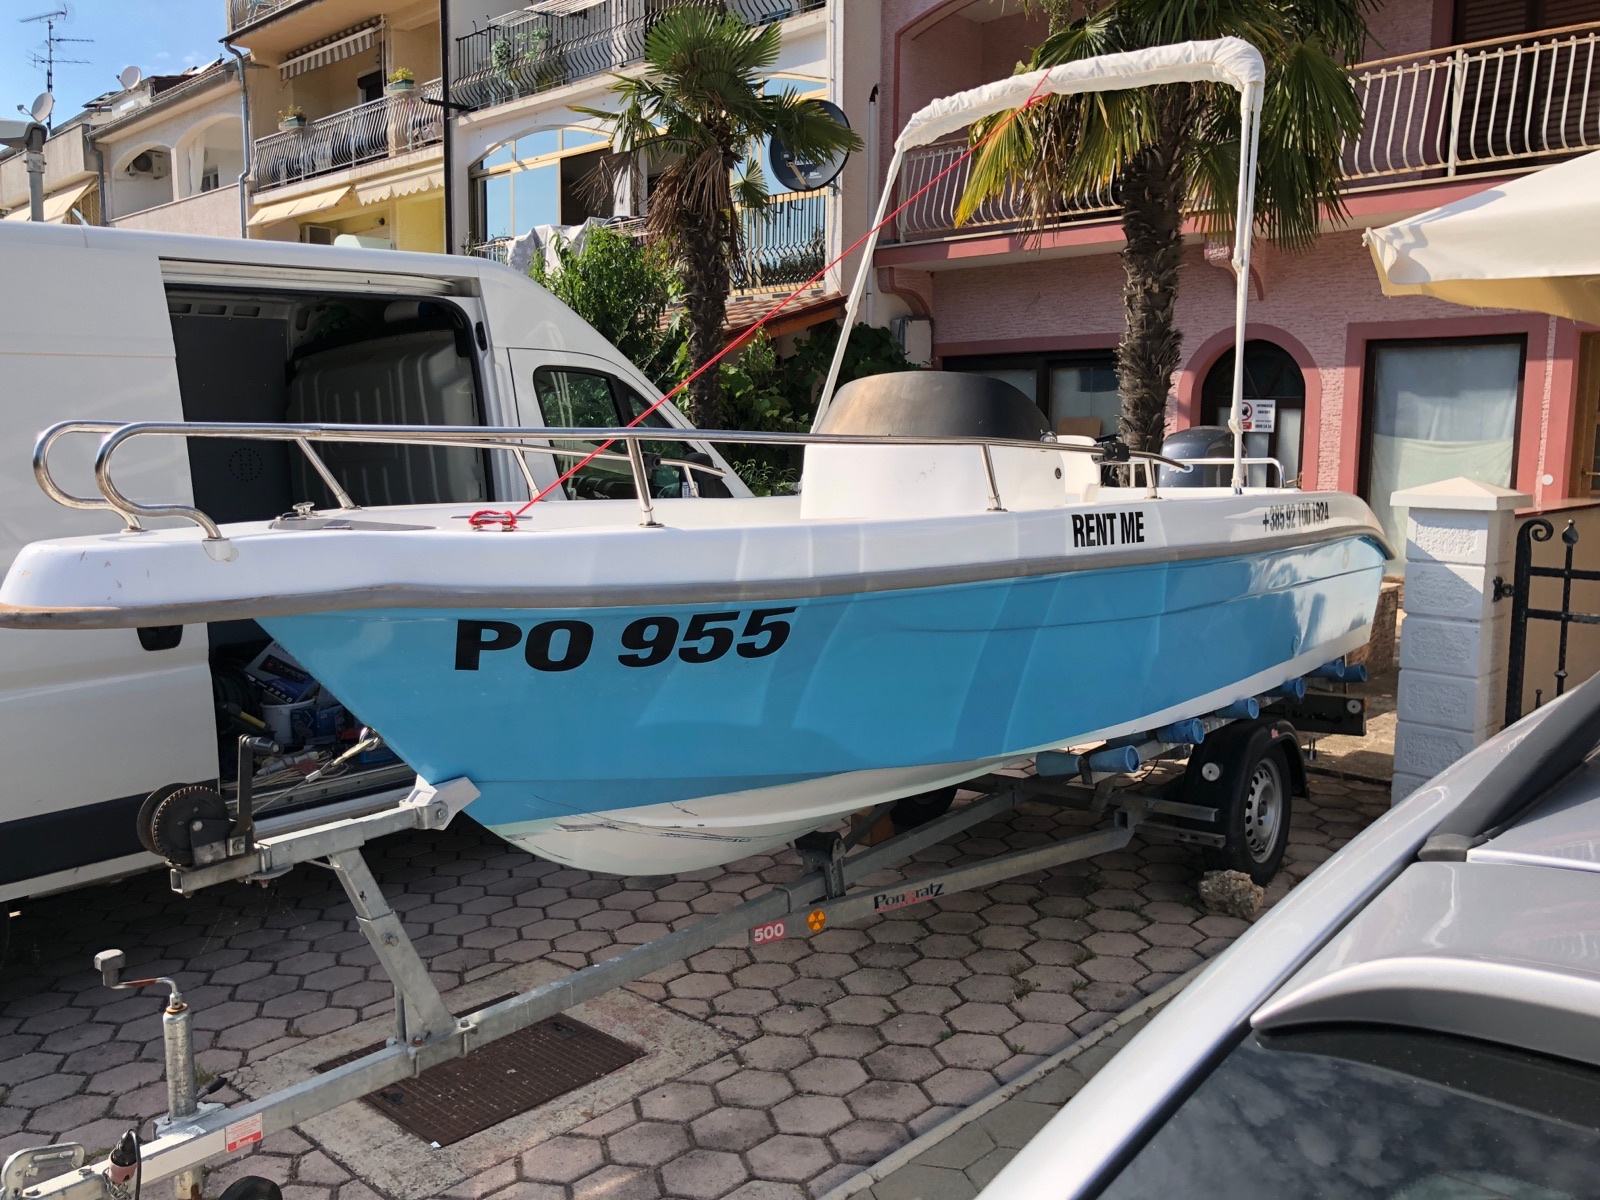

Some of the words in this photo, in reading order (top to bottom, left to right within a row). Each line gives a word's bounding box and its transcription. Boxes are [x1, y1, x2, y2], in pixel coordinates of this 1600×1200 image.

[1071, 513, 1117, 548] RENT
[1119, 511, 1145, 545] ME
[1262, 504, 1285, 533] +385
[1286, 503, 1296, 529] 92
[454, 618, 594, 673] PO
[617, 605, 799, 668] 955
[754, 923, 785, 942] 500
